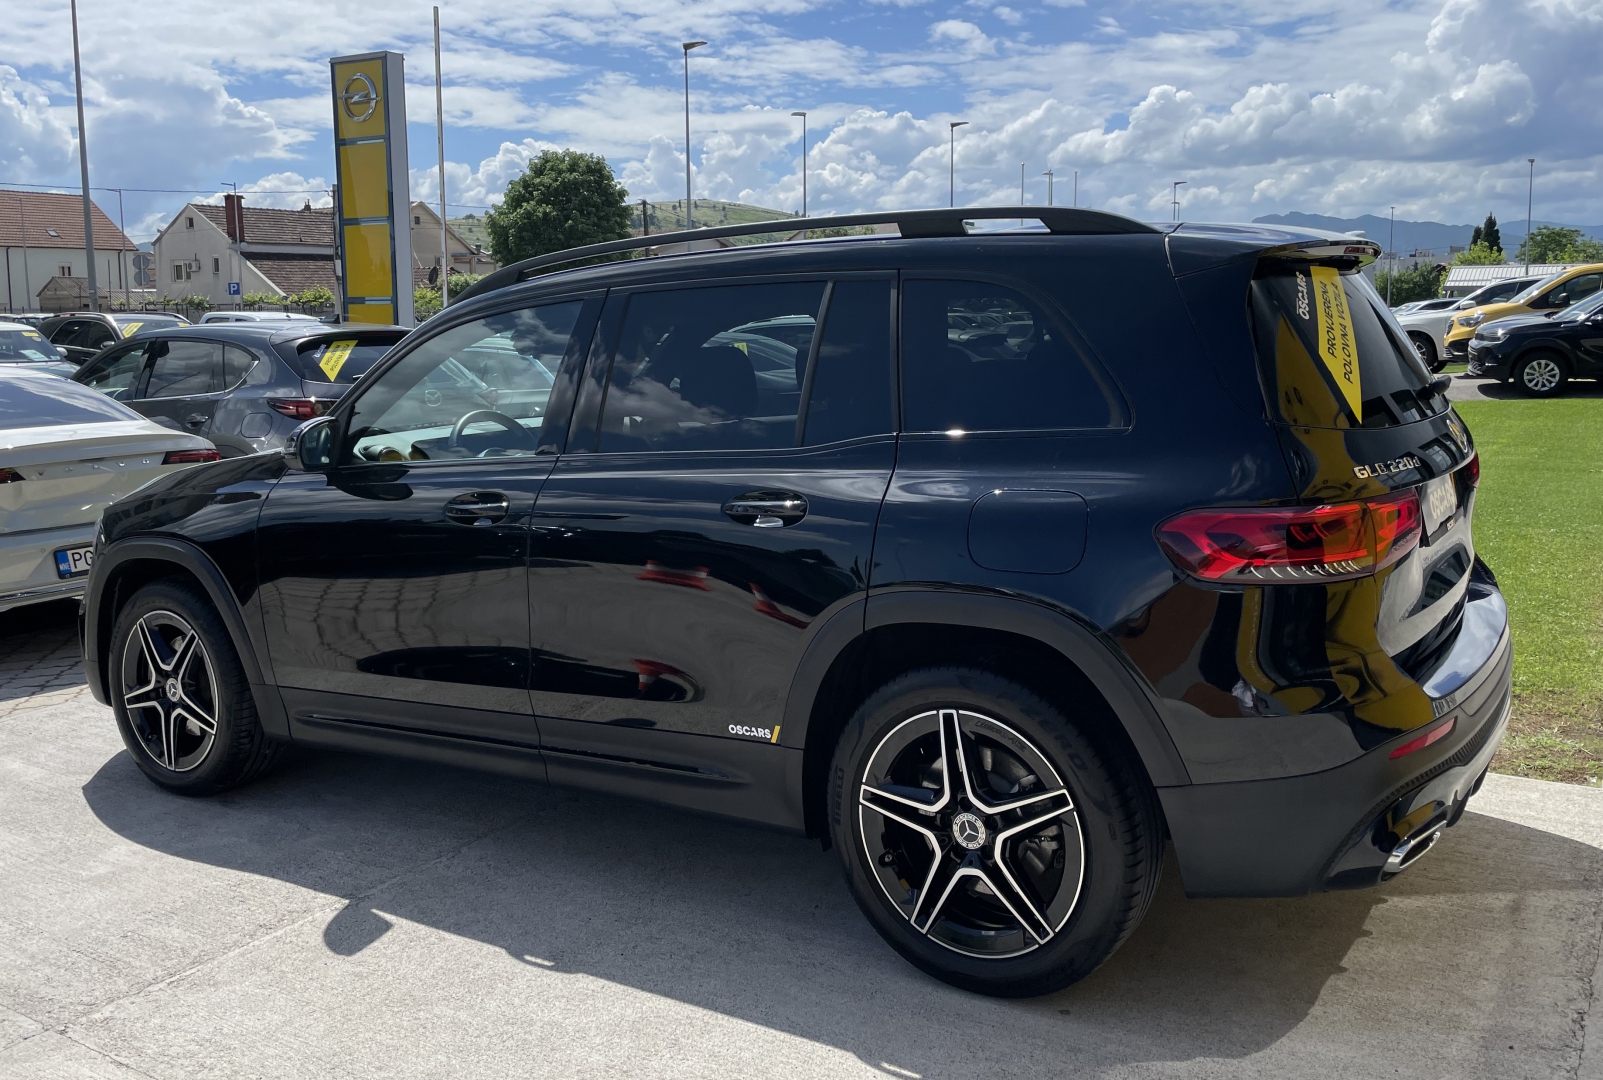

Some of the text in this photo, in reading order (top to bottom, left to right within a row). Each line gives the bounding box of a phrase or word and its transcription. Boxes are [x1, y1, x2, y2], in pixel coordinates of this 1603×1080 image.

[230, 283, 238, 294] P
[1296, 271, 1310, 320] OSCARS
[1320, 280, 1338, 359] PROVJERENA
[1331, 282, 1353, 384] POLOVNA VOZILA
[1429, 482, 1457, 520] OSCARS
[59, 562, 71, 571] MNE
[728, 724, 772, 739] OSCARS
